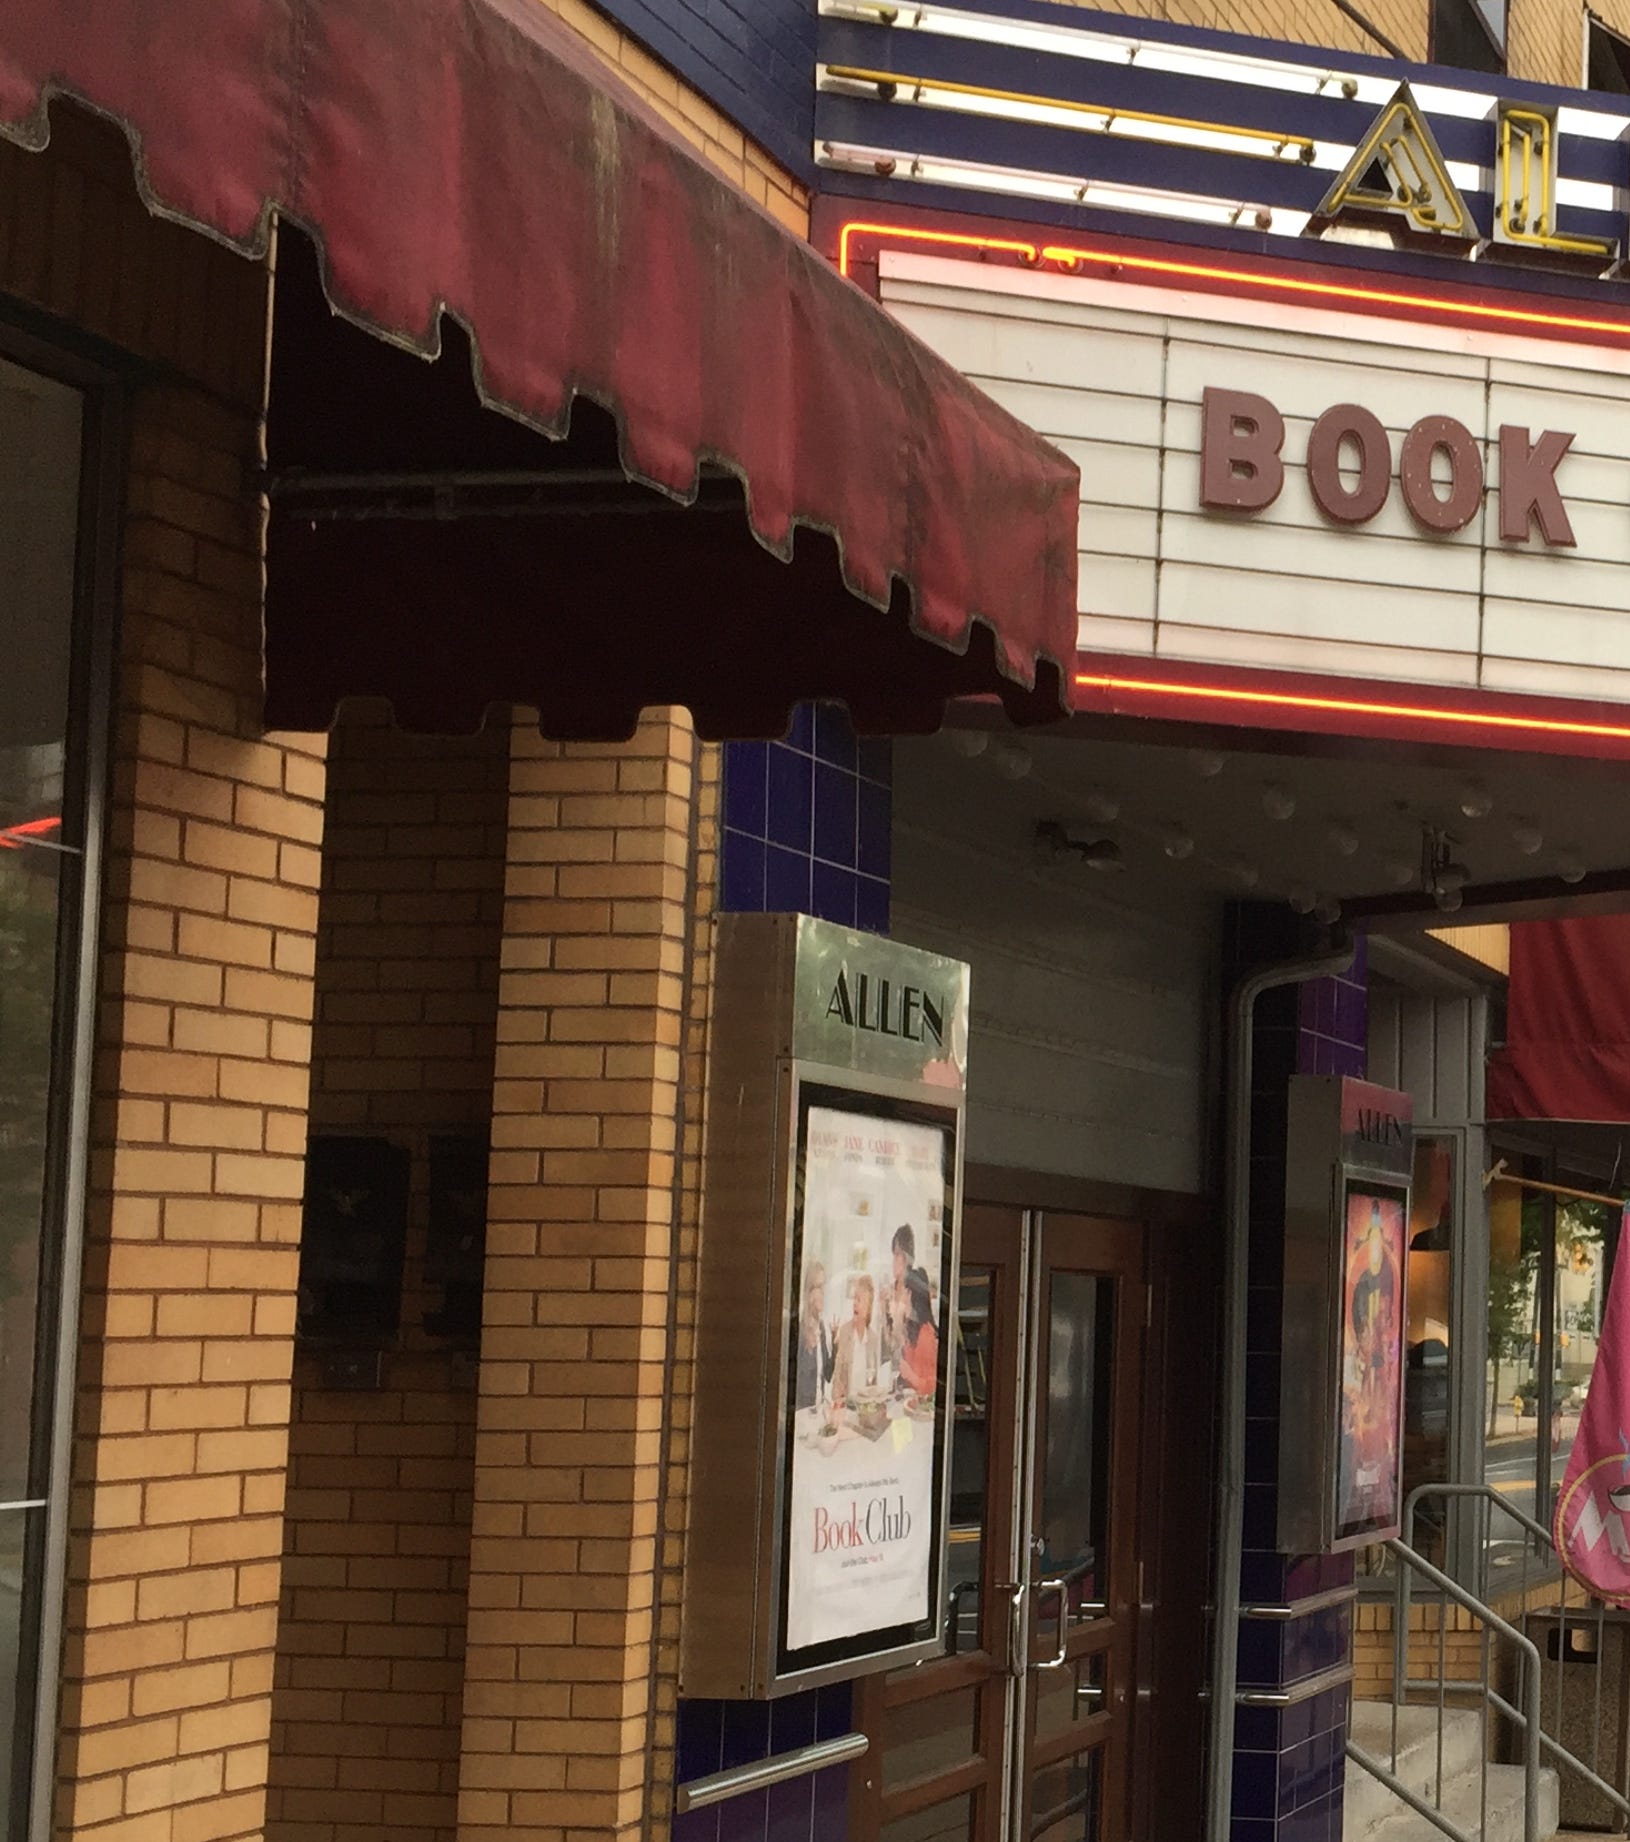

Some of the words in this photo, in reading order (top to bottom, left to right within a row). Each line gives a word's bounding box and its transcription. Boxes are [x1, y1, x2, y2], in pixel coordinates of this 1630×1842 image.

[1200, 386, 1578, 549] BOOK
[825, 966, 943, 1047] ALLEN
[1355, 1107, 1403, 1147] ALLEN
[813, 1501, 864, 1553] Book
[866, 1495, 911, 1544] Club
